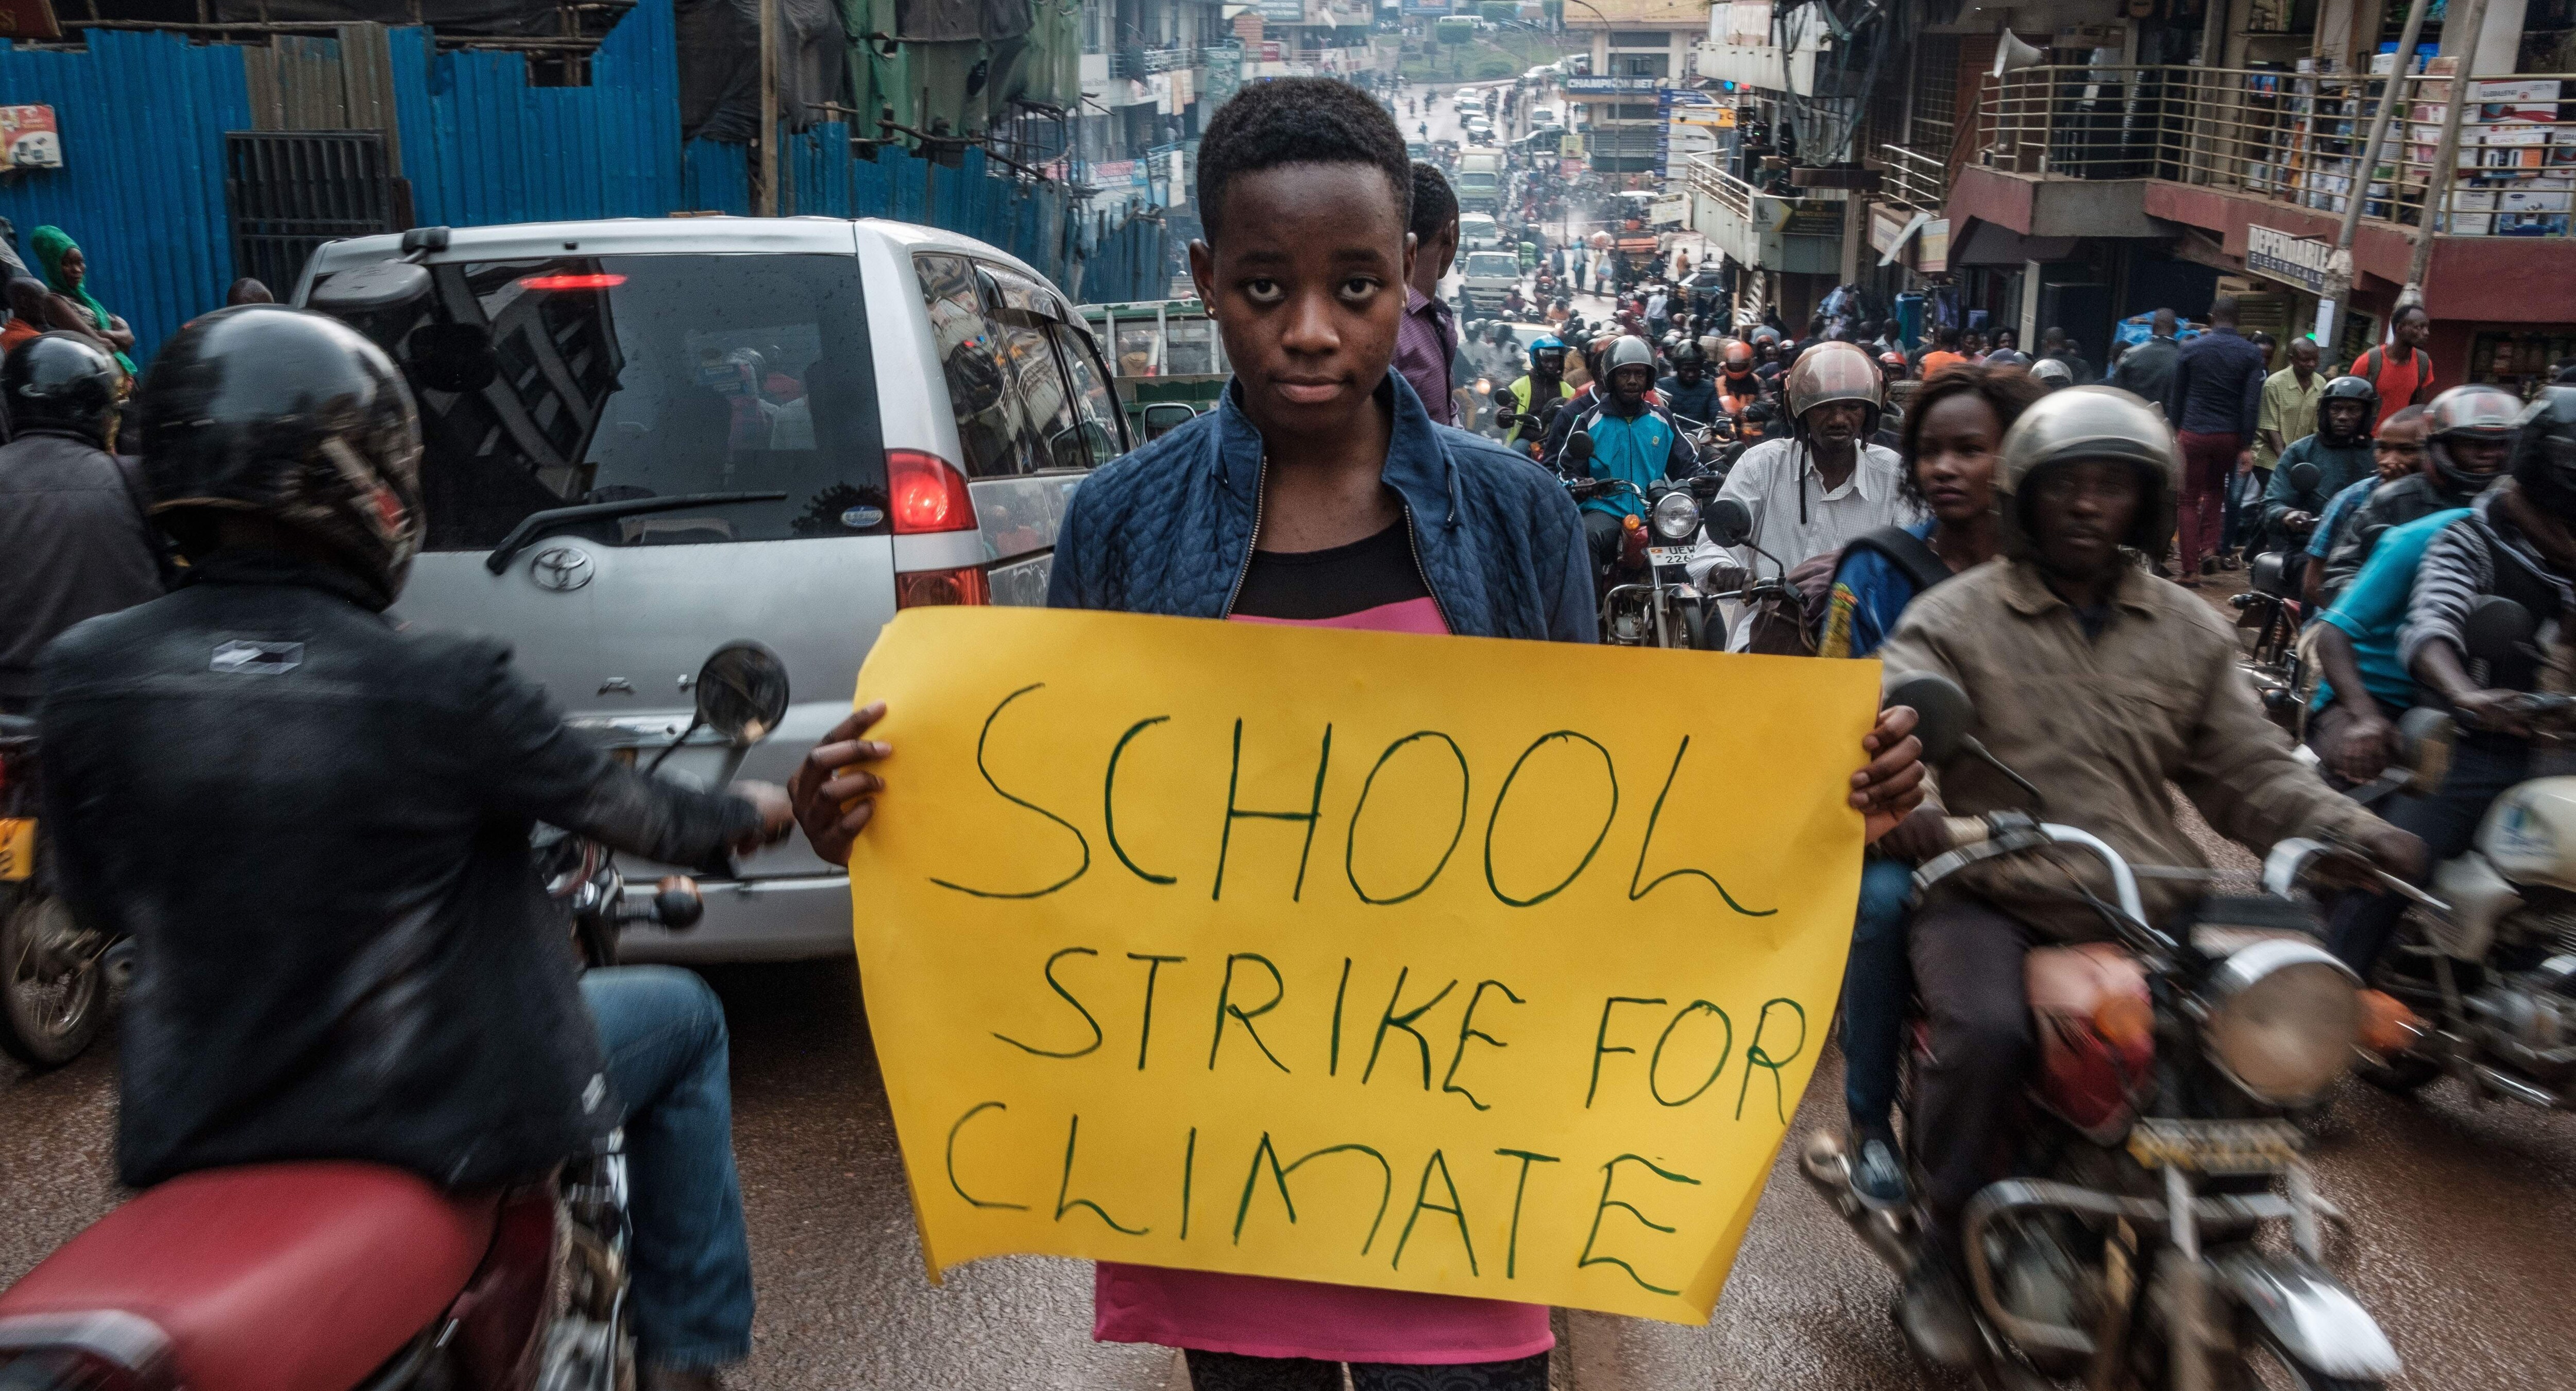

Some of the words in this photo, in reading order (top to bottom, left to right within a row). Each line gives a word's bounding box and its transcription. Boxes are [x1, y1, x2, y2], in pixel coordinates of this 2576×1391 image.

[1567, 78, 1634, 88] CHAMPION
[1634, 79, 1655, 88] BET
[2249, 227, 2328, 274] DEPENDABLE
[2251, 253, 2323, 284] ELECTRICALS
[1669, 546, 1695, 554] UEW
[931, 685, 1777, 917] SCHOOL
[994, 947, 1525, 1111] STRIKE
[1586, 997, 1805, 1121] FOR
[947, 1102, 1700, 1295] CLIMATE
